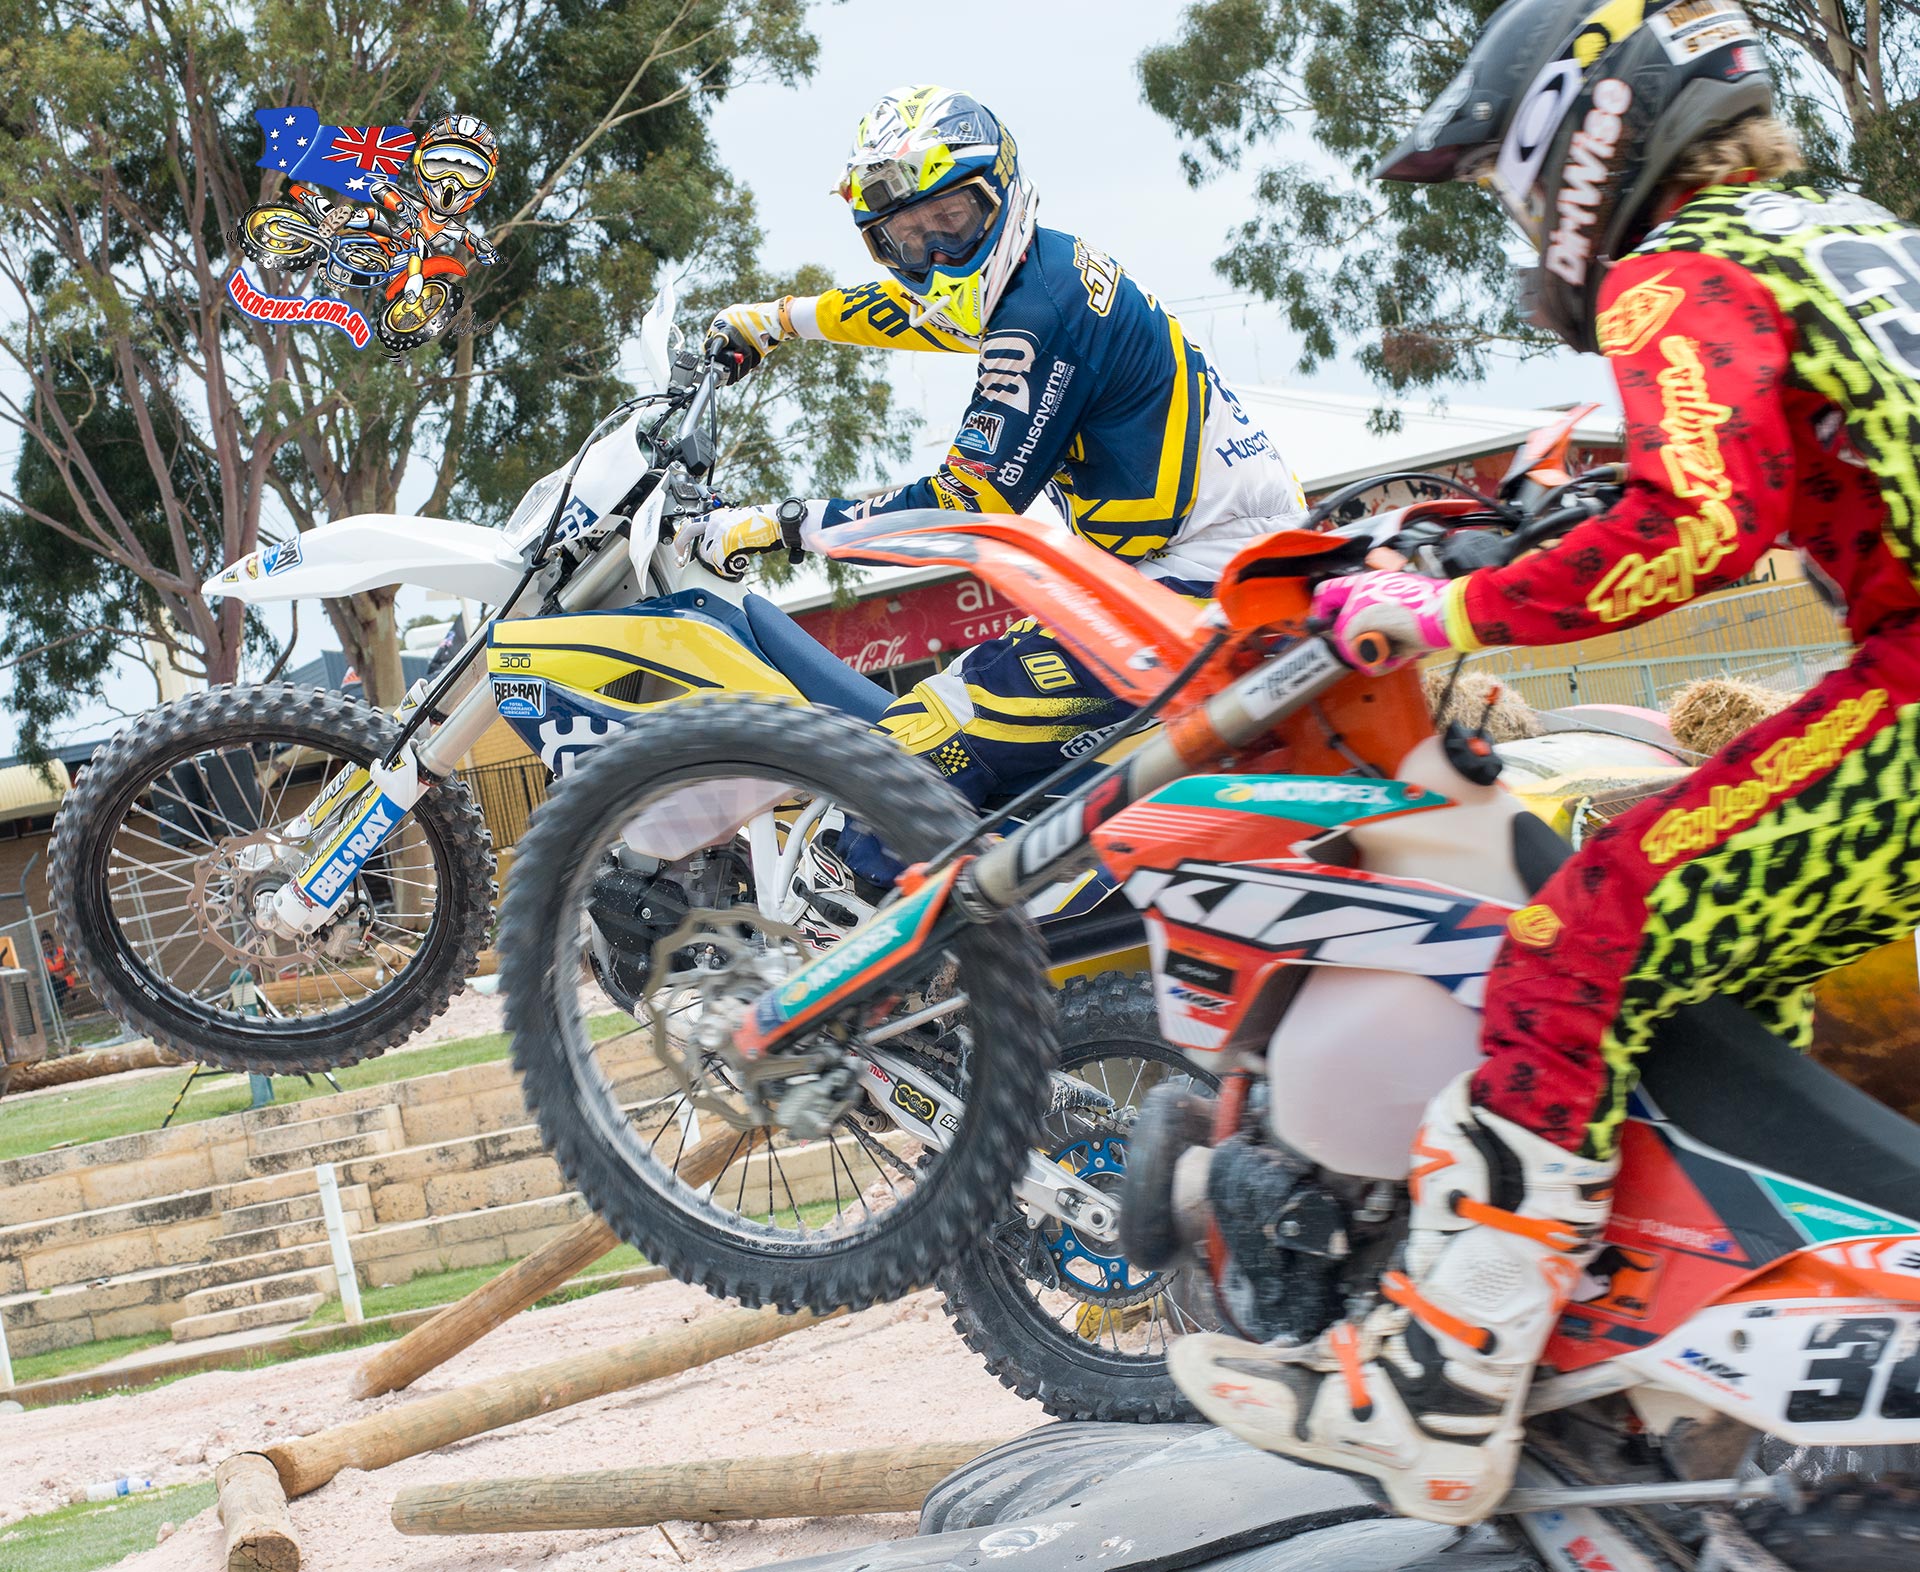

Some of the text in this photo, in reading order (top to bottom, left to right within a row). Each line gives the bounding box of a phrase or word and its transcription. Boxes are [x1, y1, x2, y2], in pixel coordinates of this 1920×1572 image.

[1013, 360, 1067, 463] Husqvarna
[963, 614, 1014, 639] CAFÉ
[500, 657, 530, 668] 300
[929, 751, 951, 778] CONTACT
